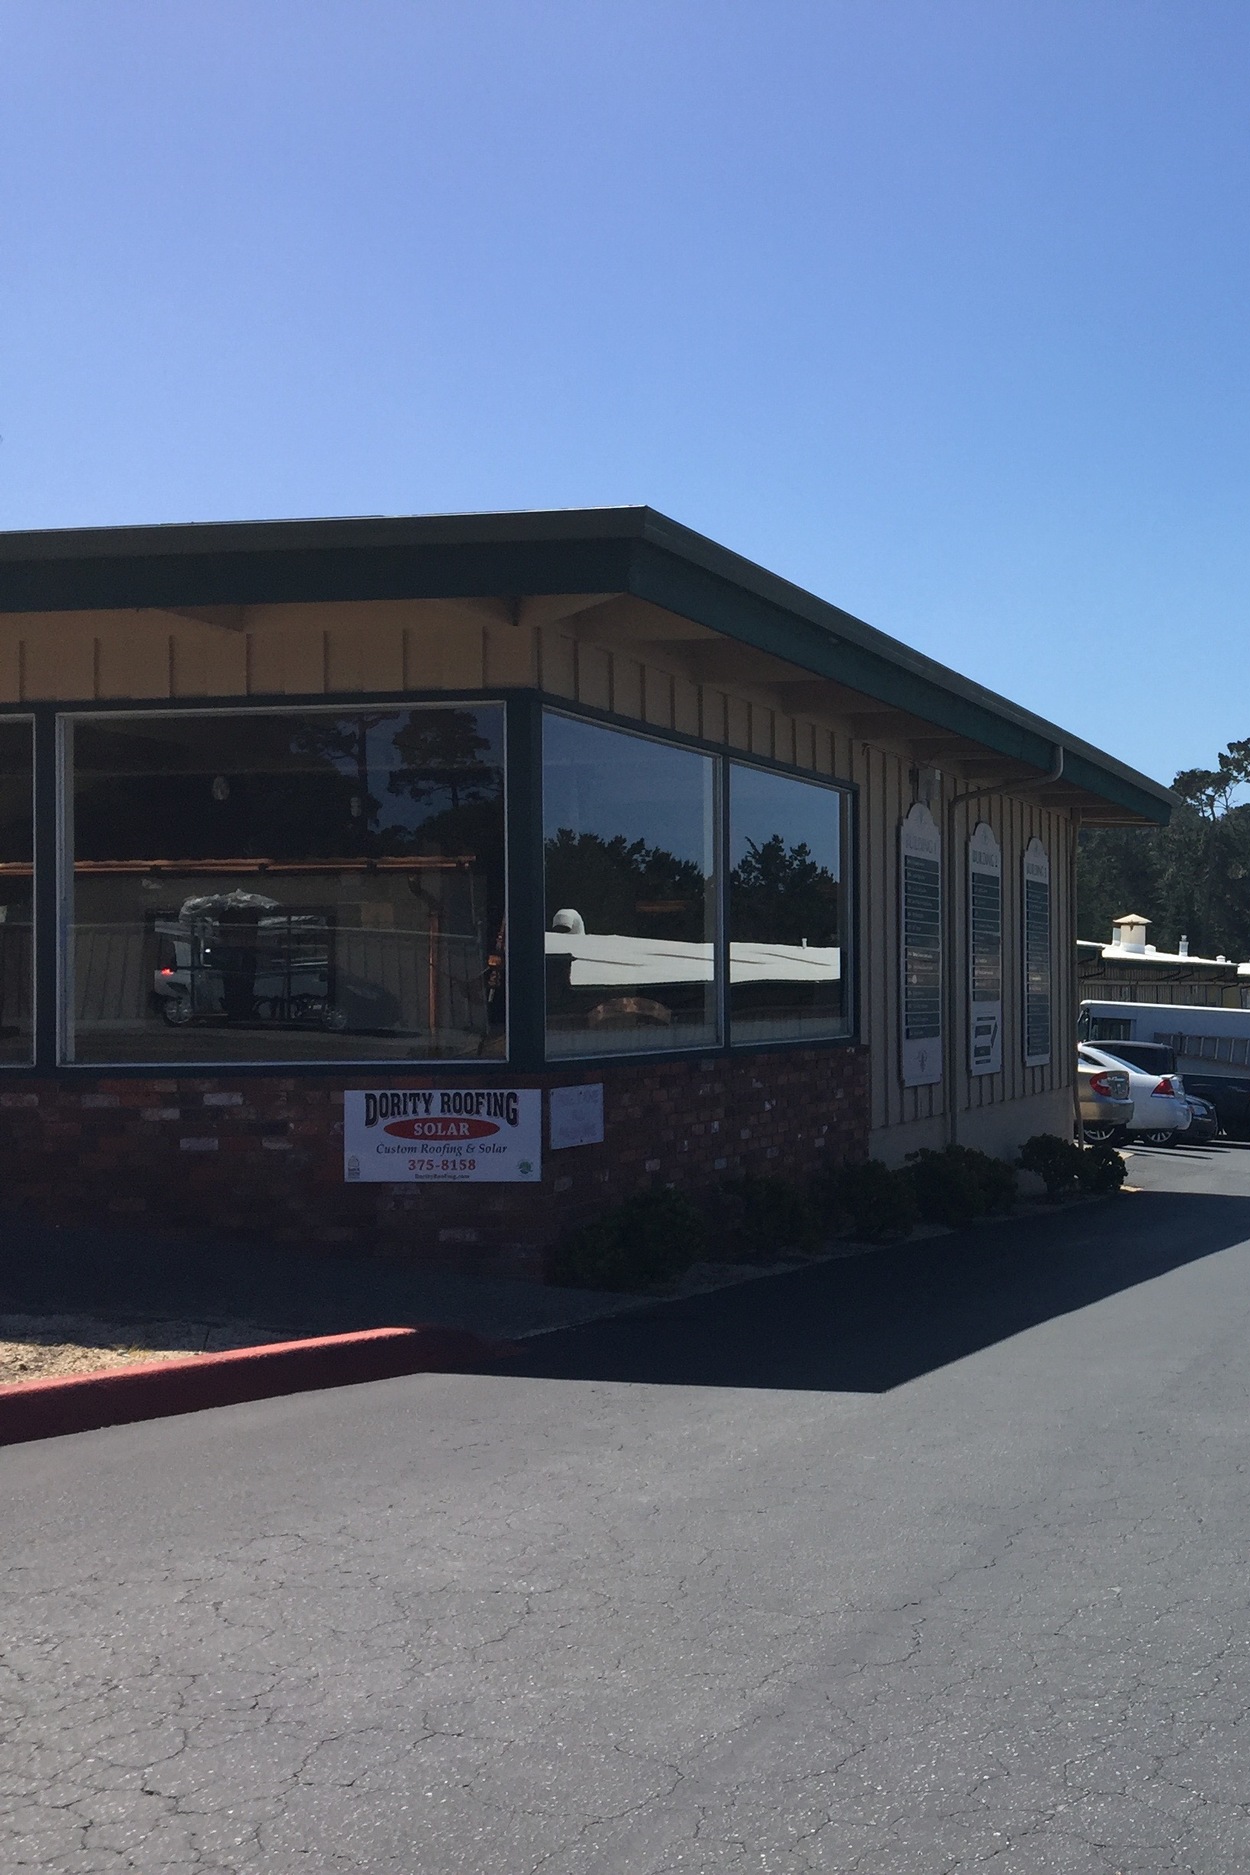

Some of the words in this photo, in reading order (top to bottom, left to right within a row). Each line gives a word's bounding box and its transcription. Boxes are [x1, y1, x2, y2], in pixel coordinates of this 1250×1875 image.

[364, 1092, 433, 1127] DORITY
[440, 1092, 519, 1127] ROOFING
[413, 1122, 470, 1136] SOLAR
[376, 1143, 417, 1154] Custom
[420, 1143, 462, 1156] Roofing
[465, 1143, 476, 1154] &
[478, 1143, 507, 1154] Solar
[408, 1159, 476, 1171] 375-8158
